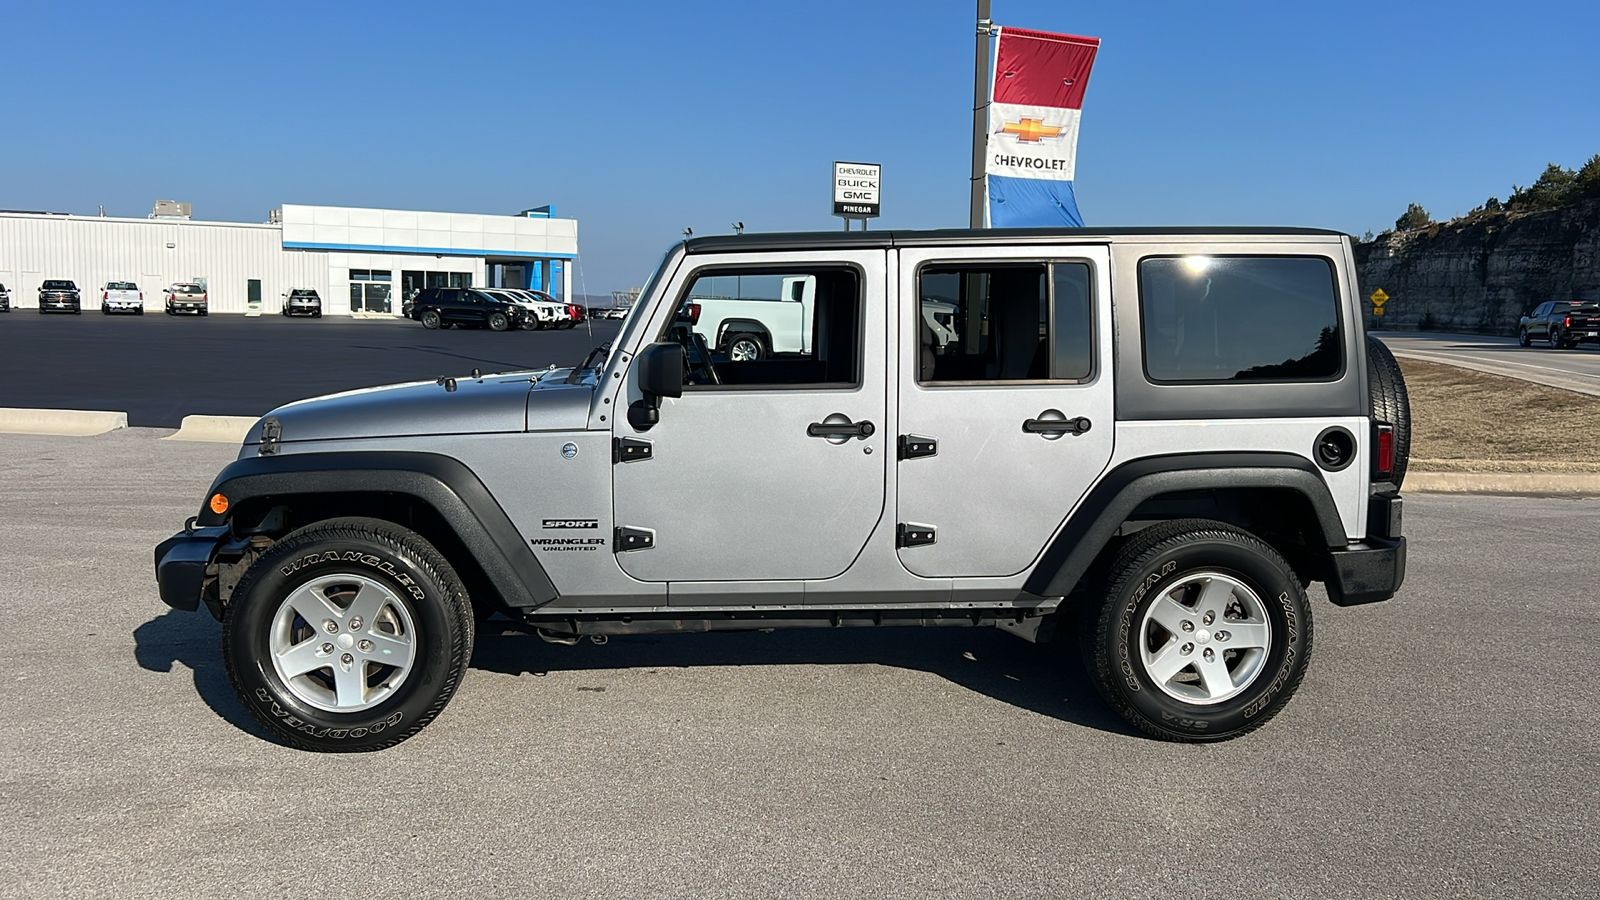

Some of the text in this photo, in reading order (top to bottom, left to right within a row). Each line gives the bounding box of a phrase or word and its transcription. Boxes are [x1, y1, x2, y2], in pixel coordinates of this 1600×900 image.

[839, 167, 877, 176] CHEVROLET
[838, 179, 877, 188] BUICK
[843, 191, 872, 200] GMC
[843, 205, 872, 213] PINEGAR
[544, 520, 598, 529] SPORT
[280, 550, 425, 601] WRANGLER
[1118, 560, 1177, 692] GOODYEAR
[1244, 591, 1299, 719] WRANGLER
[255, 687, 404, 739] GOODYEAR
